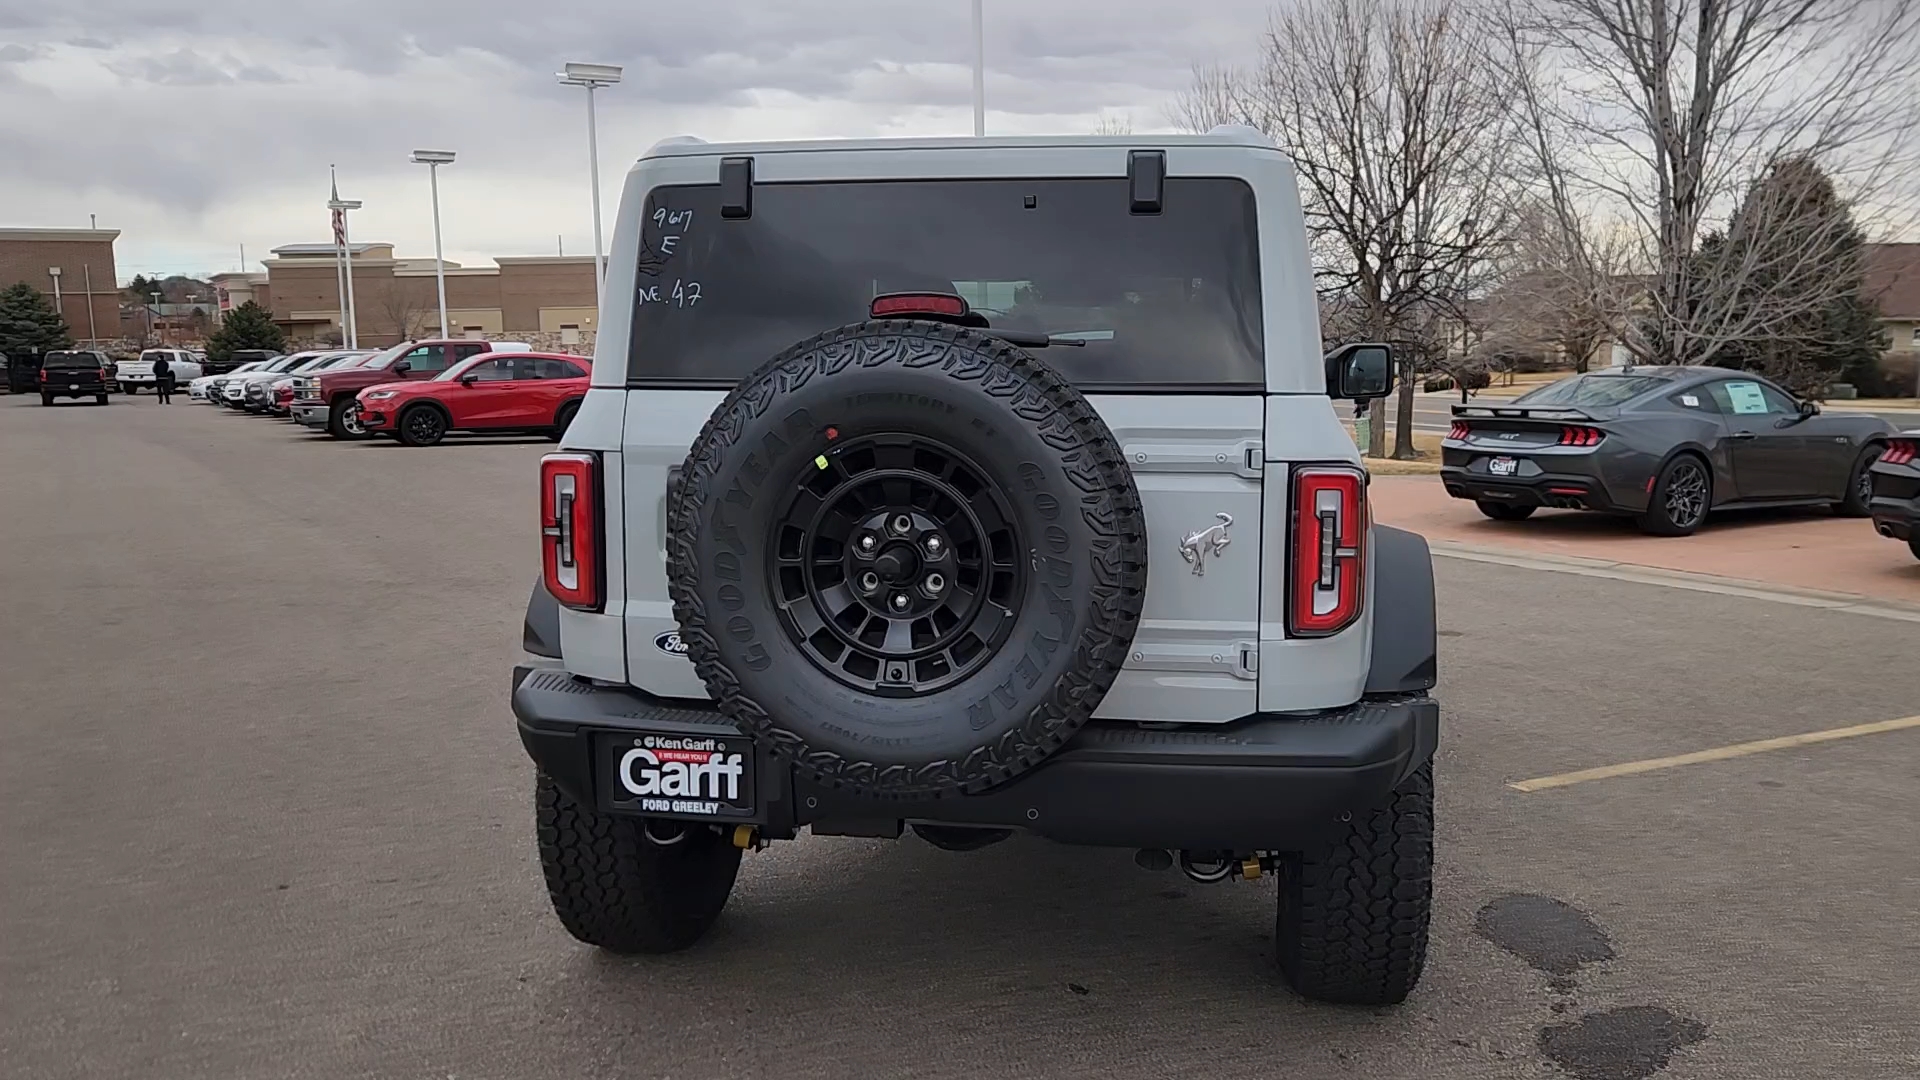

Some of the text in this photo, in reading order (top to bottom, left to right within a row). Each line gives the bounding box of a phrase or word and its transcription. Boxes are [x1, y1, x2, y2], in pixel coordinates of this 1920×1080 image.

[653, 208, 693, 232] 9617
[661, 236, 680, 254] E
[1489, 458, 1517, 472] Garff
[664, 635, 689, 651] For
[656, 736, 715, 751] Ken Garff
[674, 752, 689, 760] HEAR
[690, 753, 703, 761] YOU
[619, 748, 743, 799] Garff
[642, 799, 719, 814] FORD GREELEY
